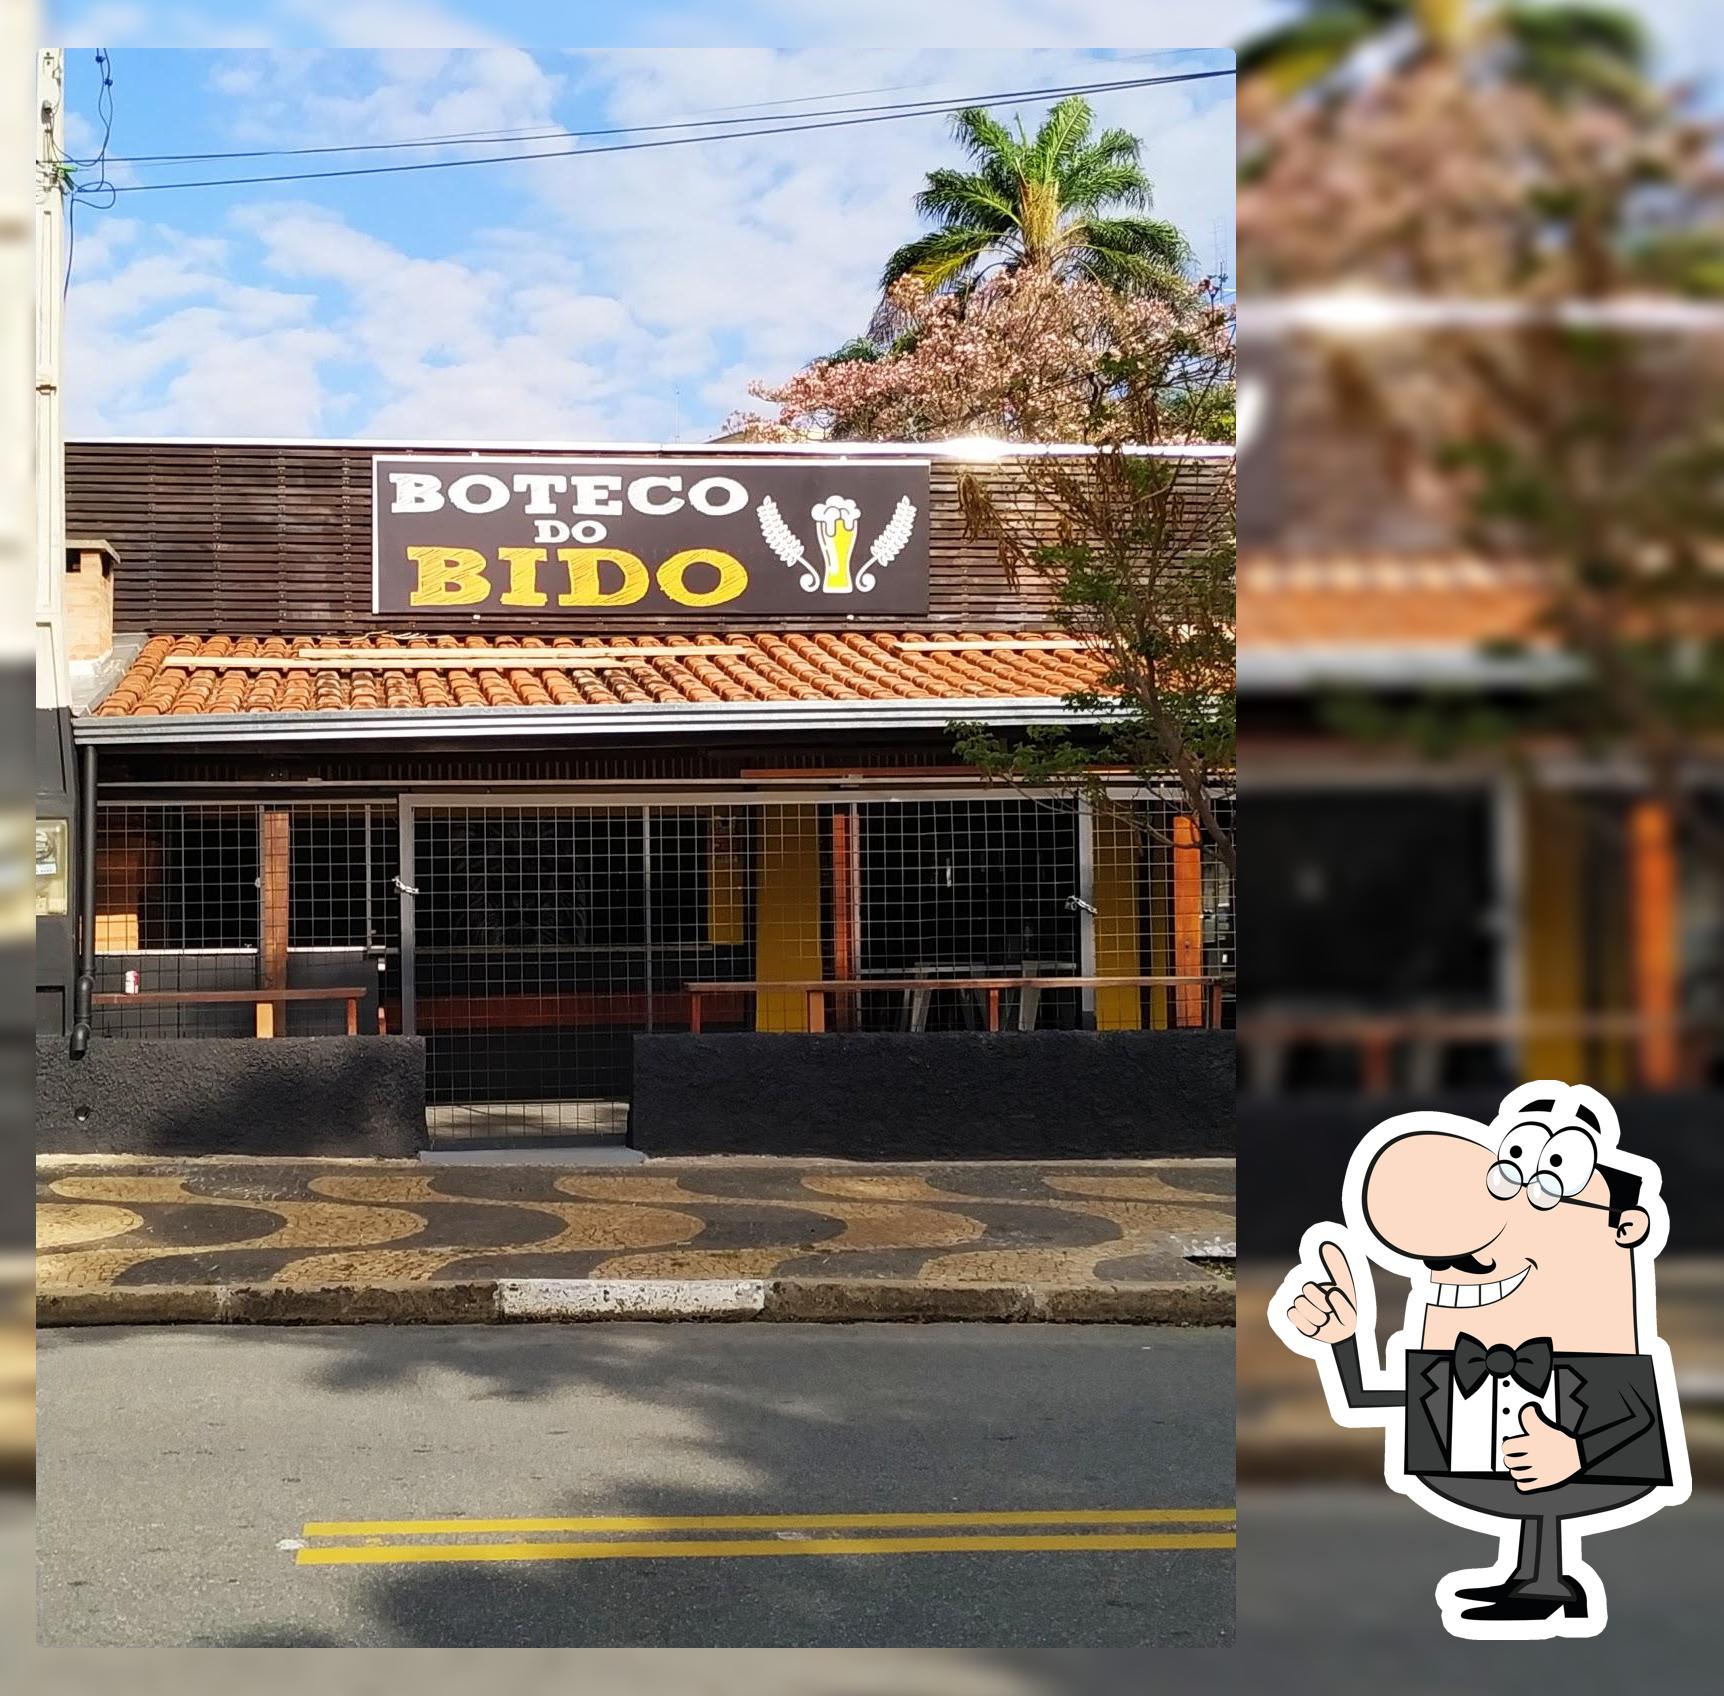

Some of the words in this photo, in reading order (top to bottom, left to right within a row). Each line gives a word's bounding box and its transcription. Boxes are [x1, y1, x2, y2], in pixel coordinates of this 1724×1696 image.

[389, 472, 749, 516] BOTECO
[533, 520, 608, 544] DO
[407, 546, 749, 608] BIDO
